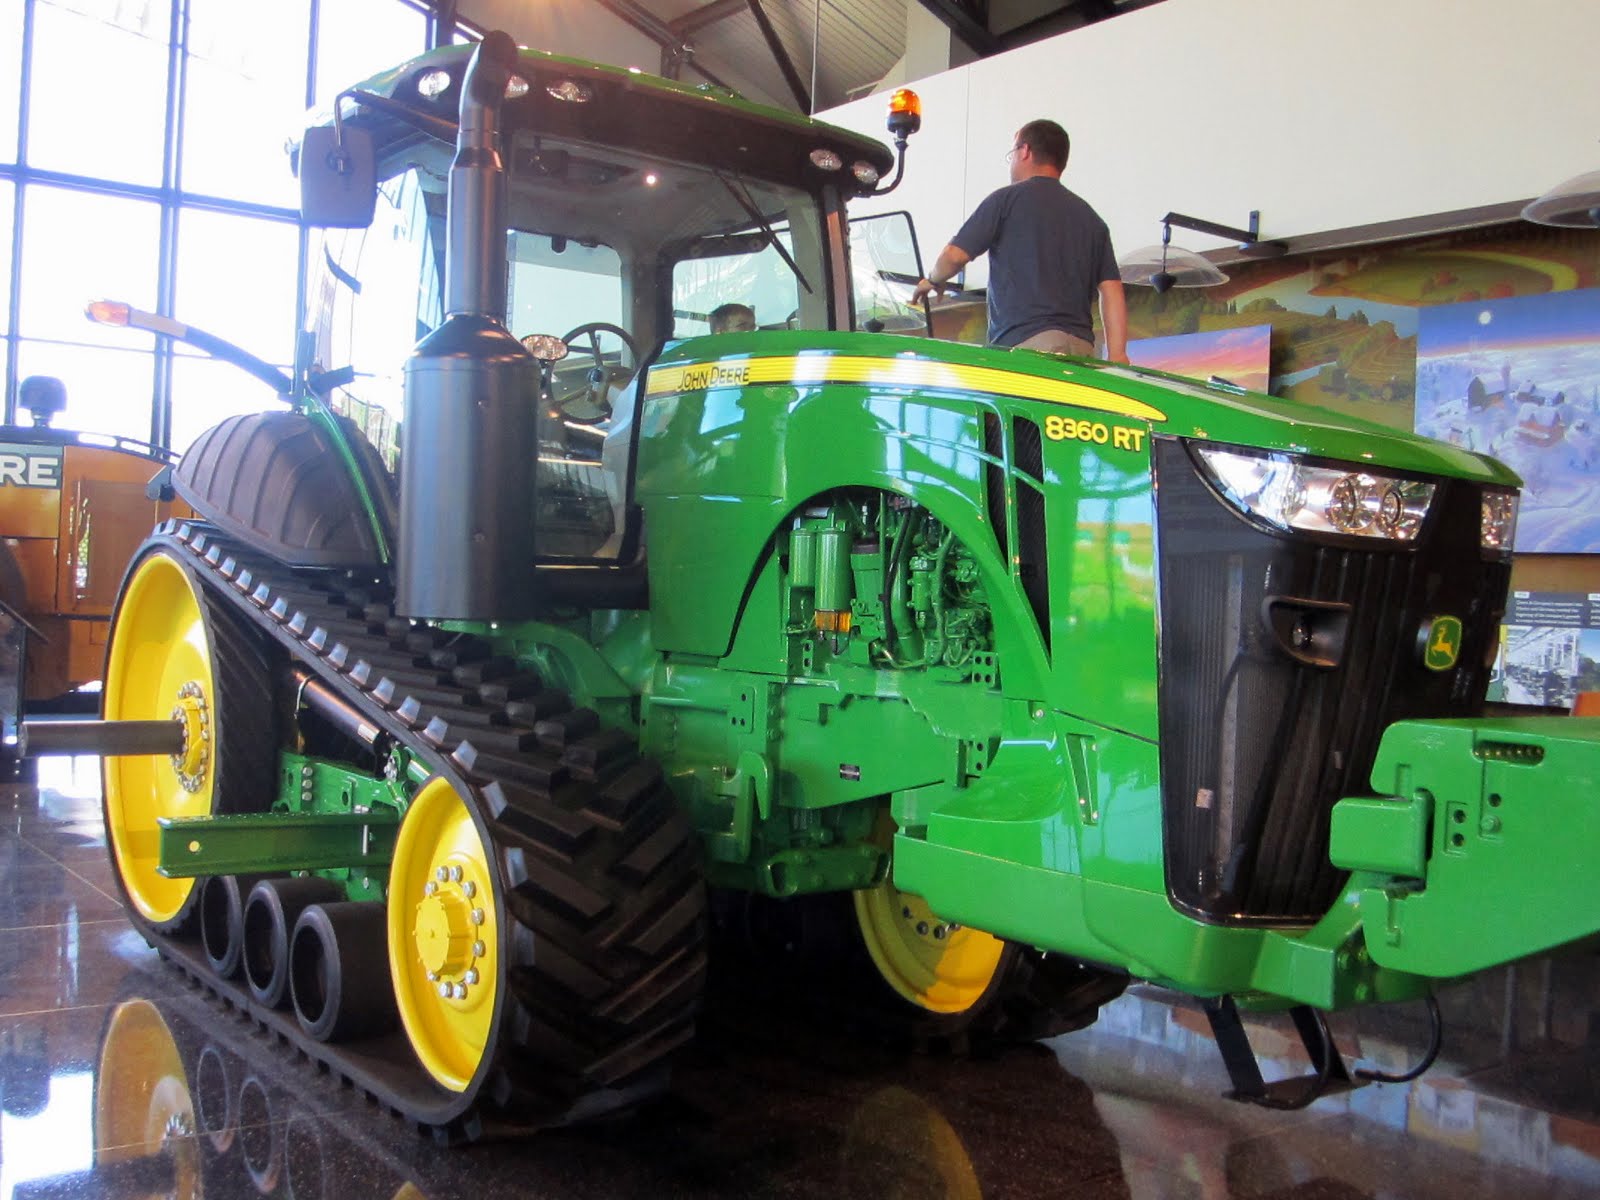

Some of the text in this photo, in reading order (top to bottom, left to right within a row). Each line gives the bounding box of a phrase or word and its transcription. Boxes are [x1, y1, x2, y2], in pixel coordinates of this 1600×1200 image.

[677, 365, 750, 390] JOHN DEERE
[1045, 415, 1145, 452] 8360 RT
[0, 456, 59, 486] RE
